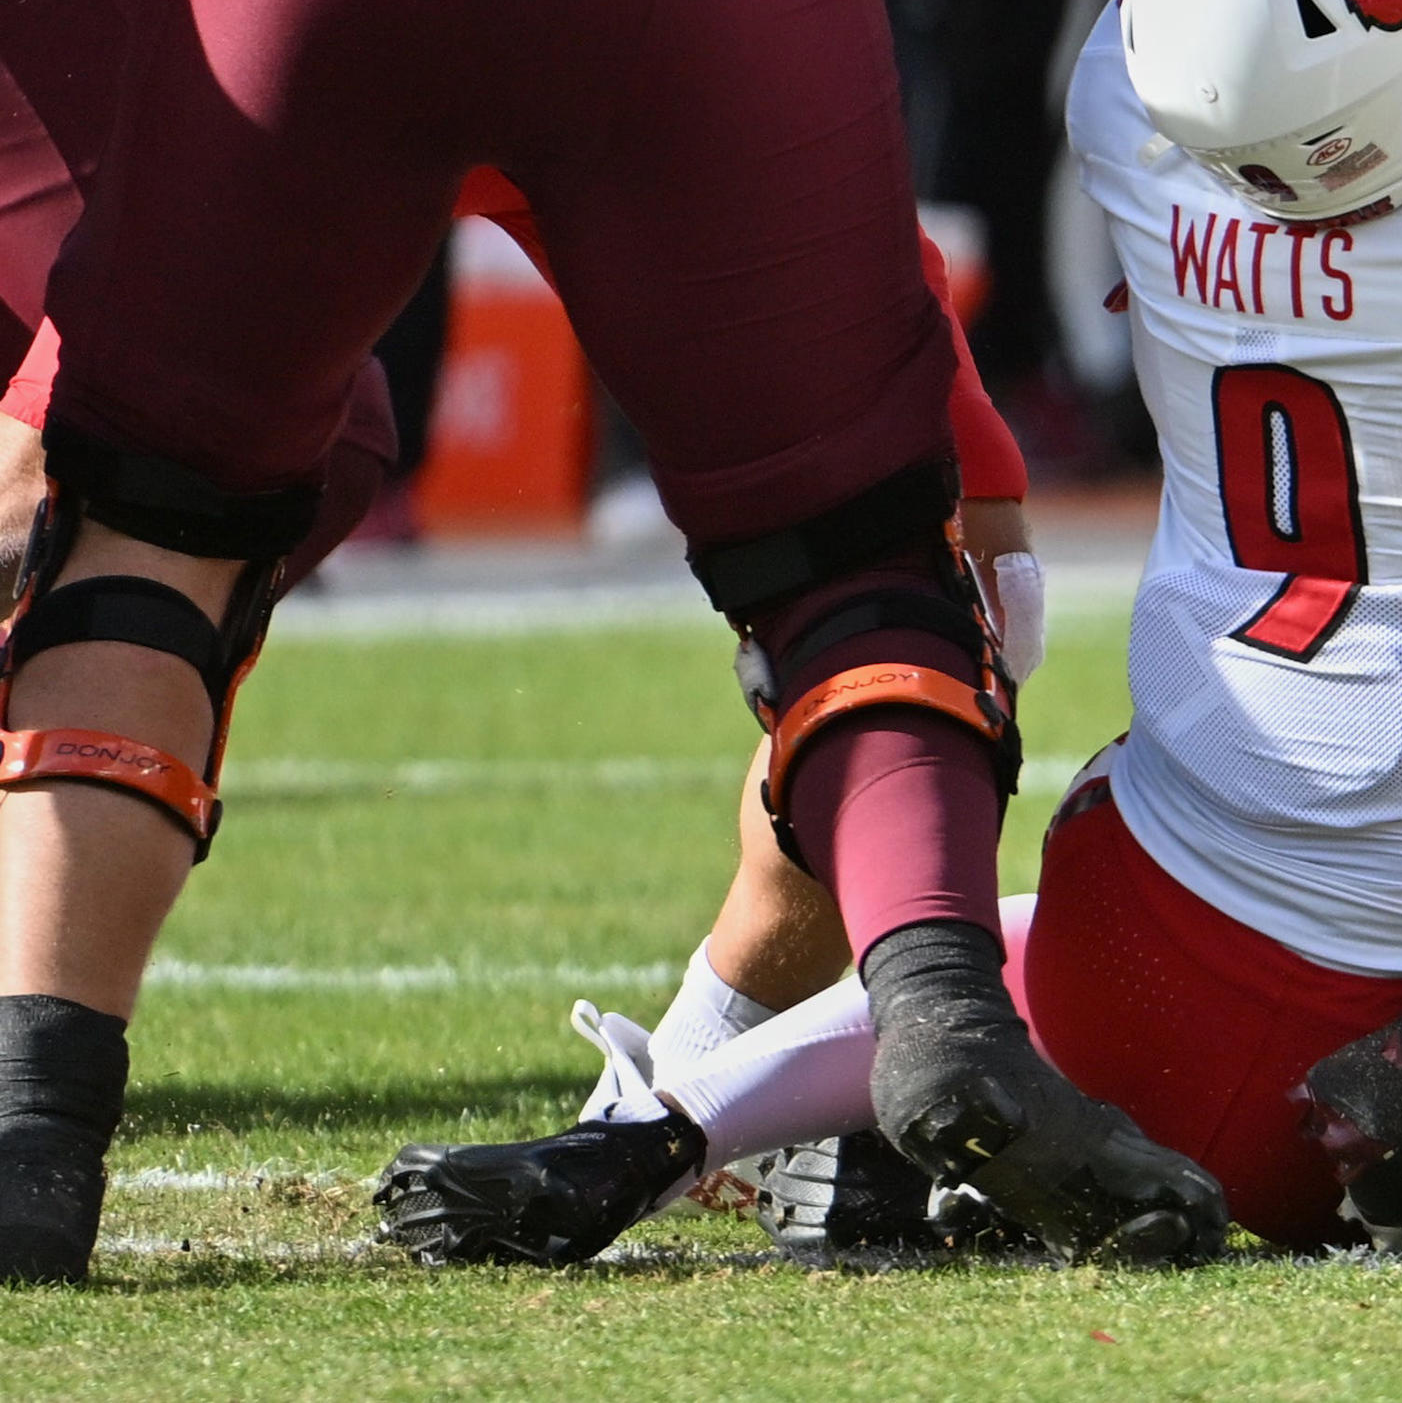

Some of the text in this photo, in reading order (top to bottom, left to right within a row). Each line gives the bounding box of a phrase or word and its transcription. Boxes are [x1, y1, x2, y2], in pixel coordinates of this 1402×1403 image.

[1170, 204, 1354, 321] WATTS
[1210, 362, 1370, 664] 9
[55, 742, 172, 774] DONJOY
